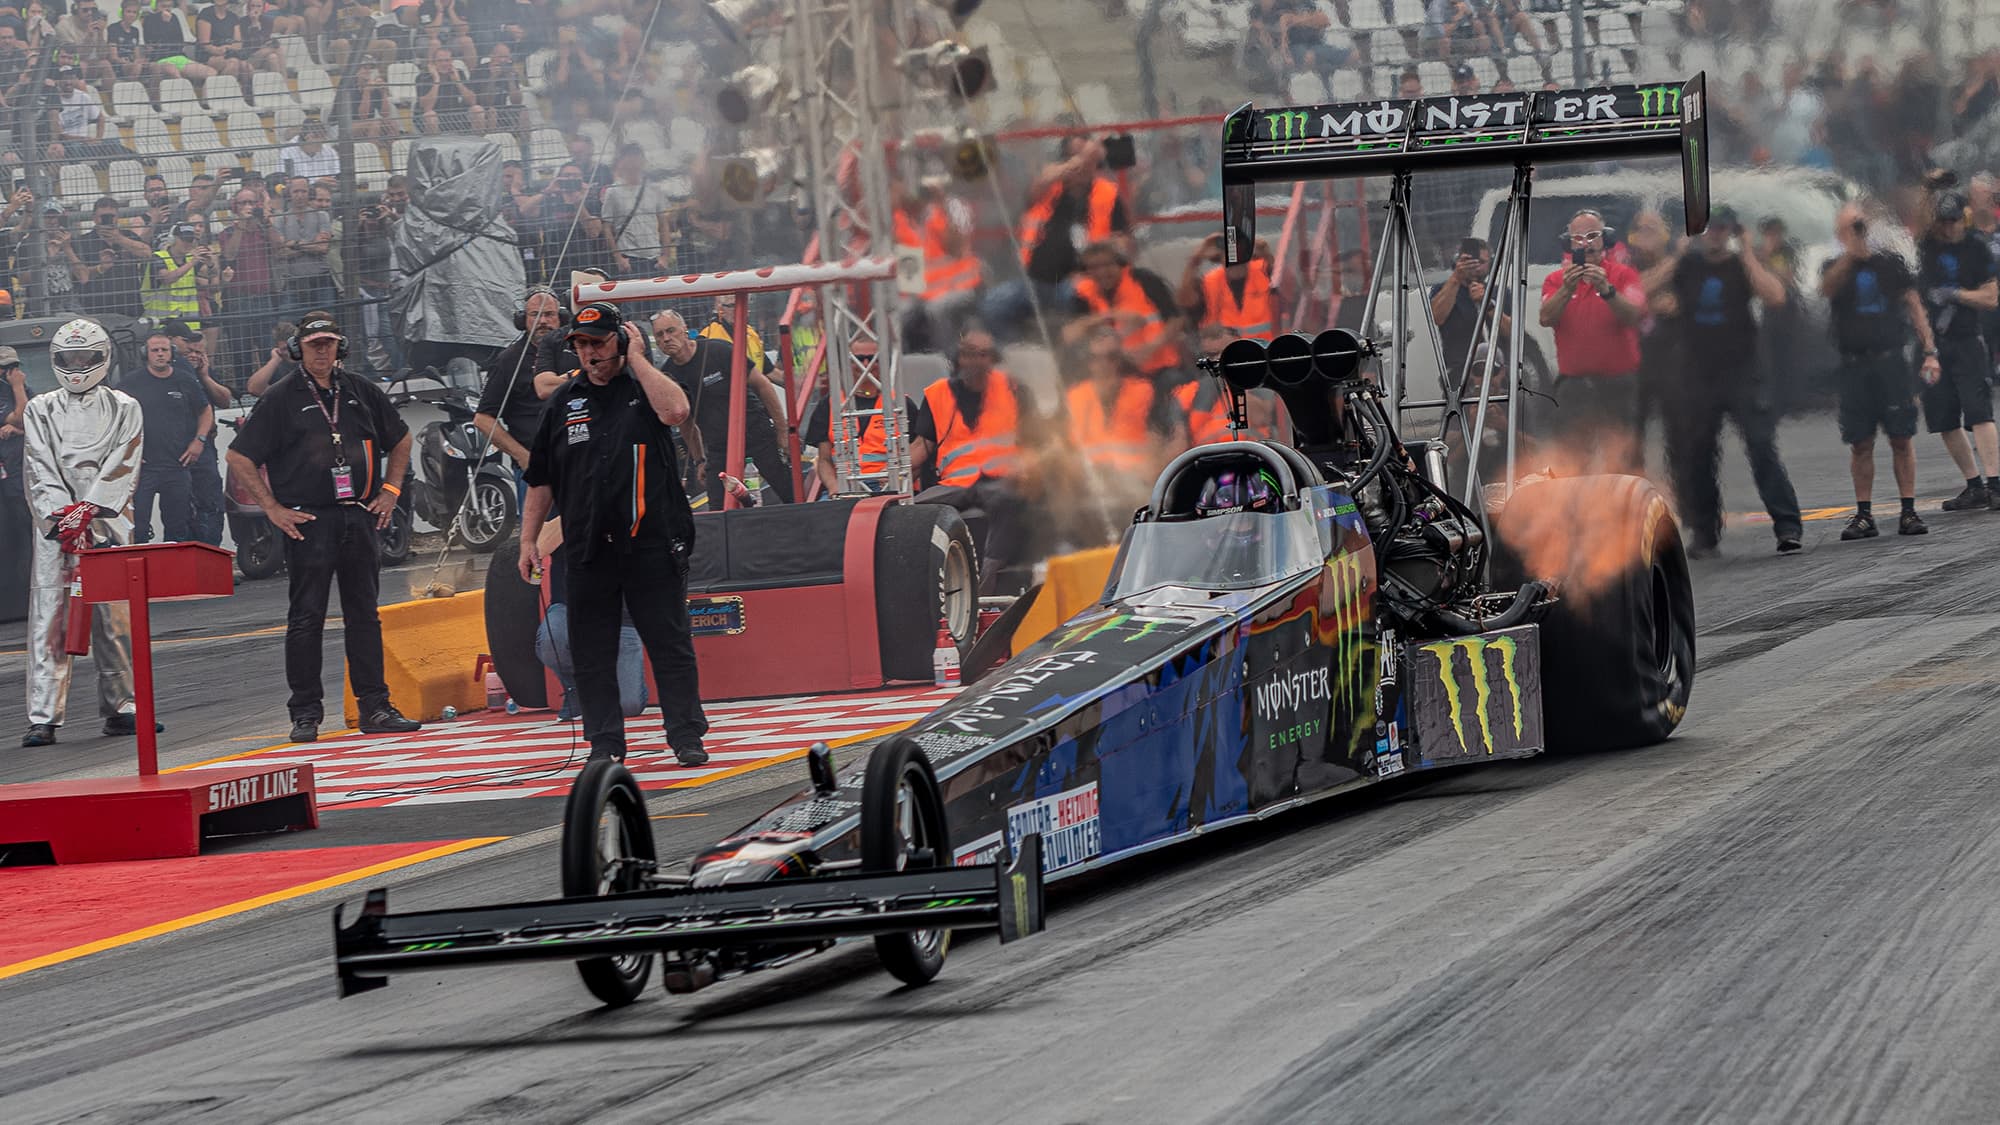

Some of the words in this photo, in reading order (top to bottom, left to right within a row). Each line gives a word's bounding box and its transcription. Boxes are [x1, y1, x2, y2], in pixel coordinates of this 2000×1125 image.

[1320, 93, 1620, 143] MONSTER
[567, 423, 589, 435] FIA
[1206, 505, 1244, 517] SIMPSON
[1257, 666, 1331, 720] MONSTER
[1269, 719, 1320, 750] ENERGY
[208, 776, 259, 811] START
[263, 769, 298, 799] LINE
